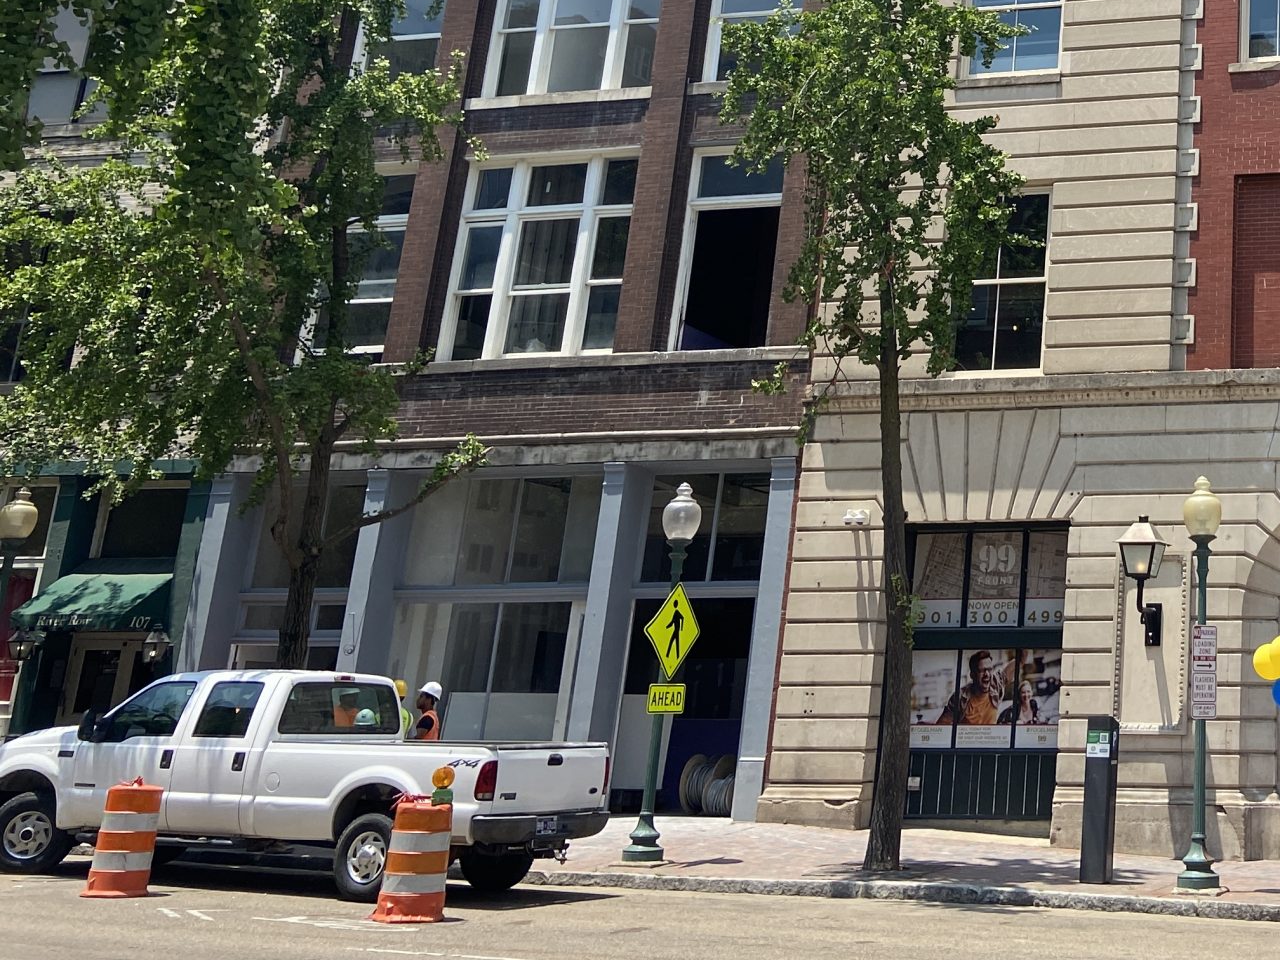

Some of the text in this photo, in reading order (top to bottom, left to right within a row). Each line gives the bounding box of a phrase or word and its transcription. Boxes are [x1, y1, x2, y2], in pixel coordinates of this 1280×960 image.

[979, 544, 1017, 573] 99
[977, 575, 1014, 585] FRONT
[968, 601, 1018, 610] NOW OPEN
[129, 616, 151, 629] 107
[651, 691, 682, 707] AHEAD
